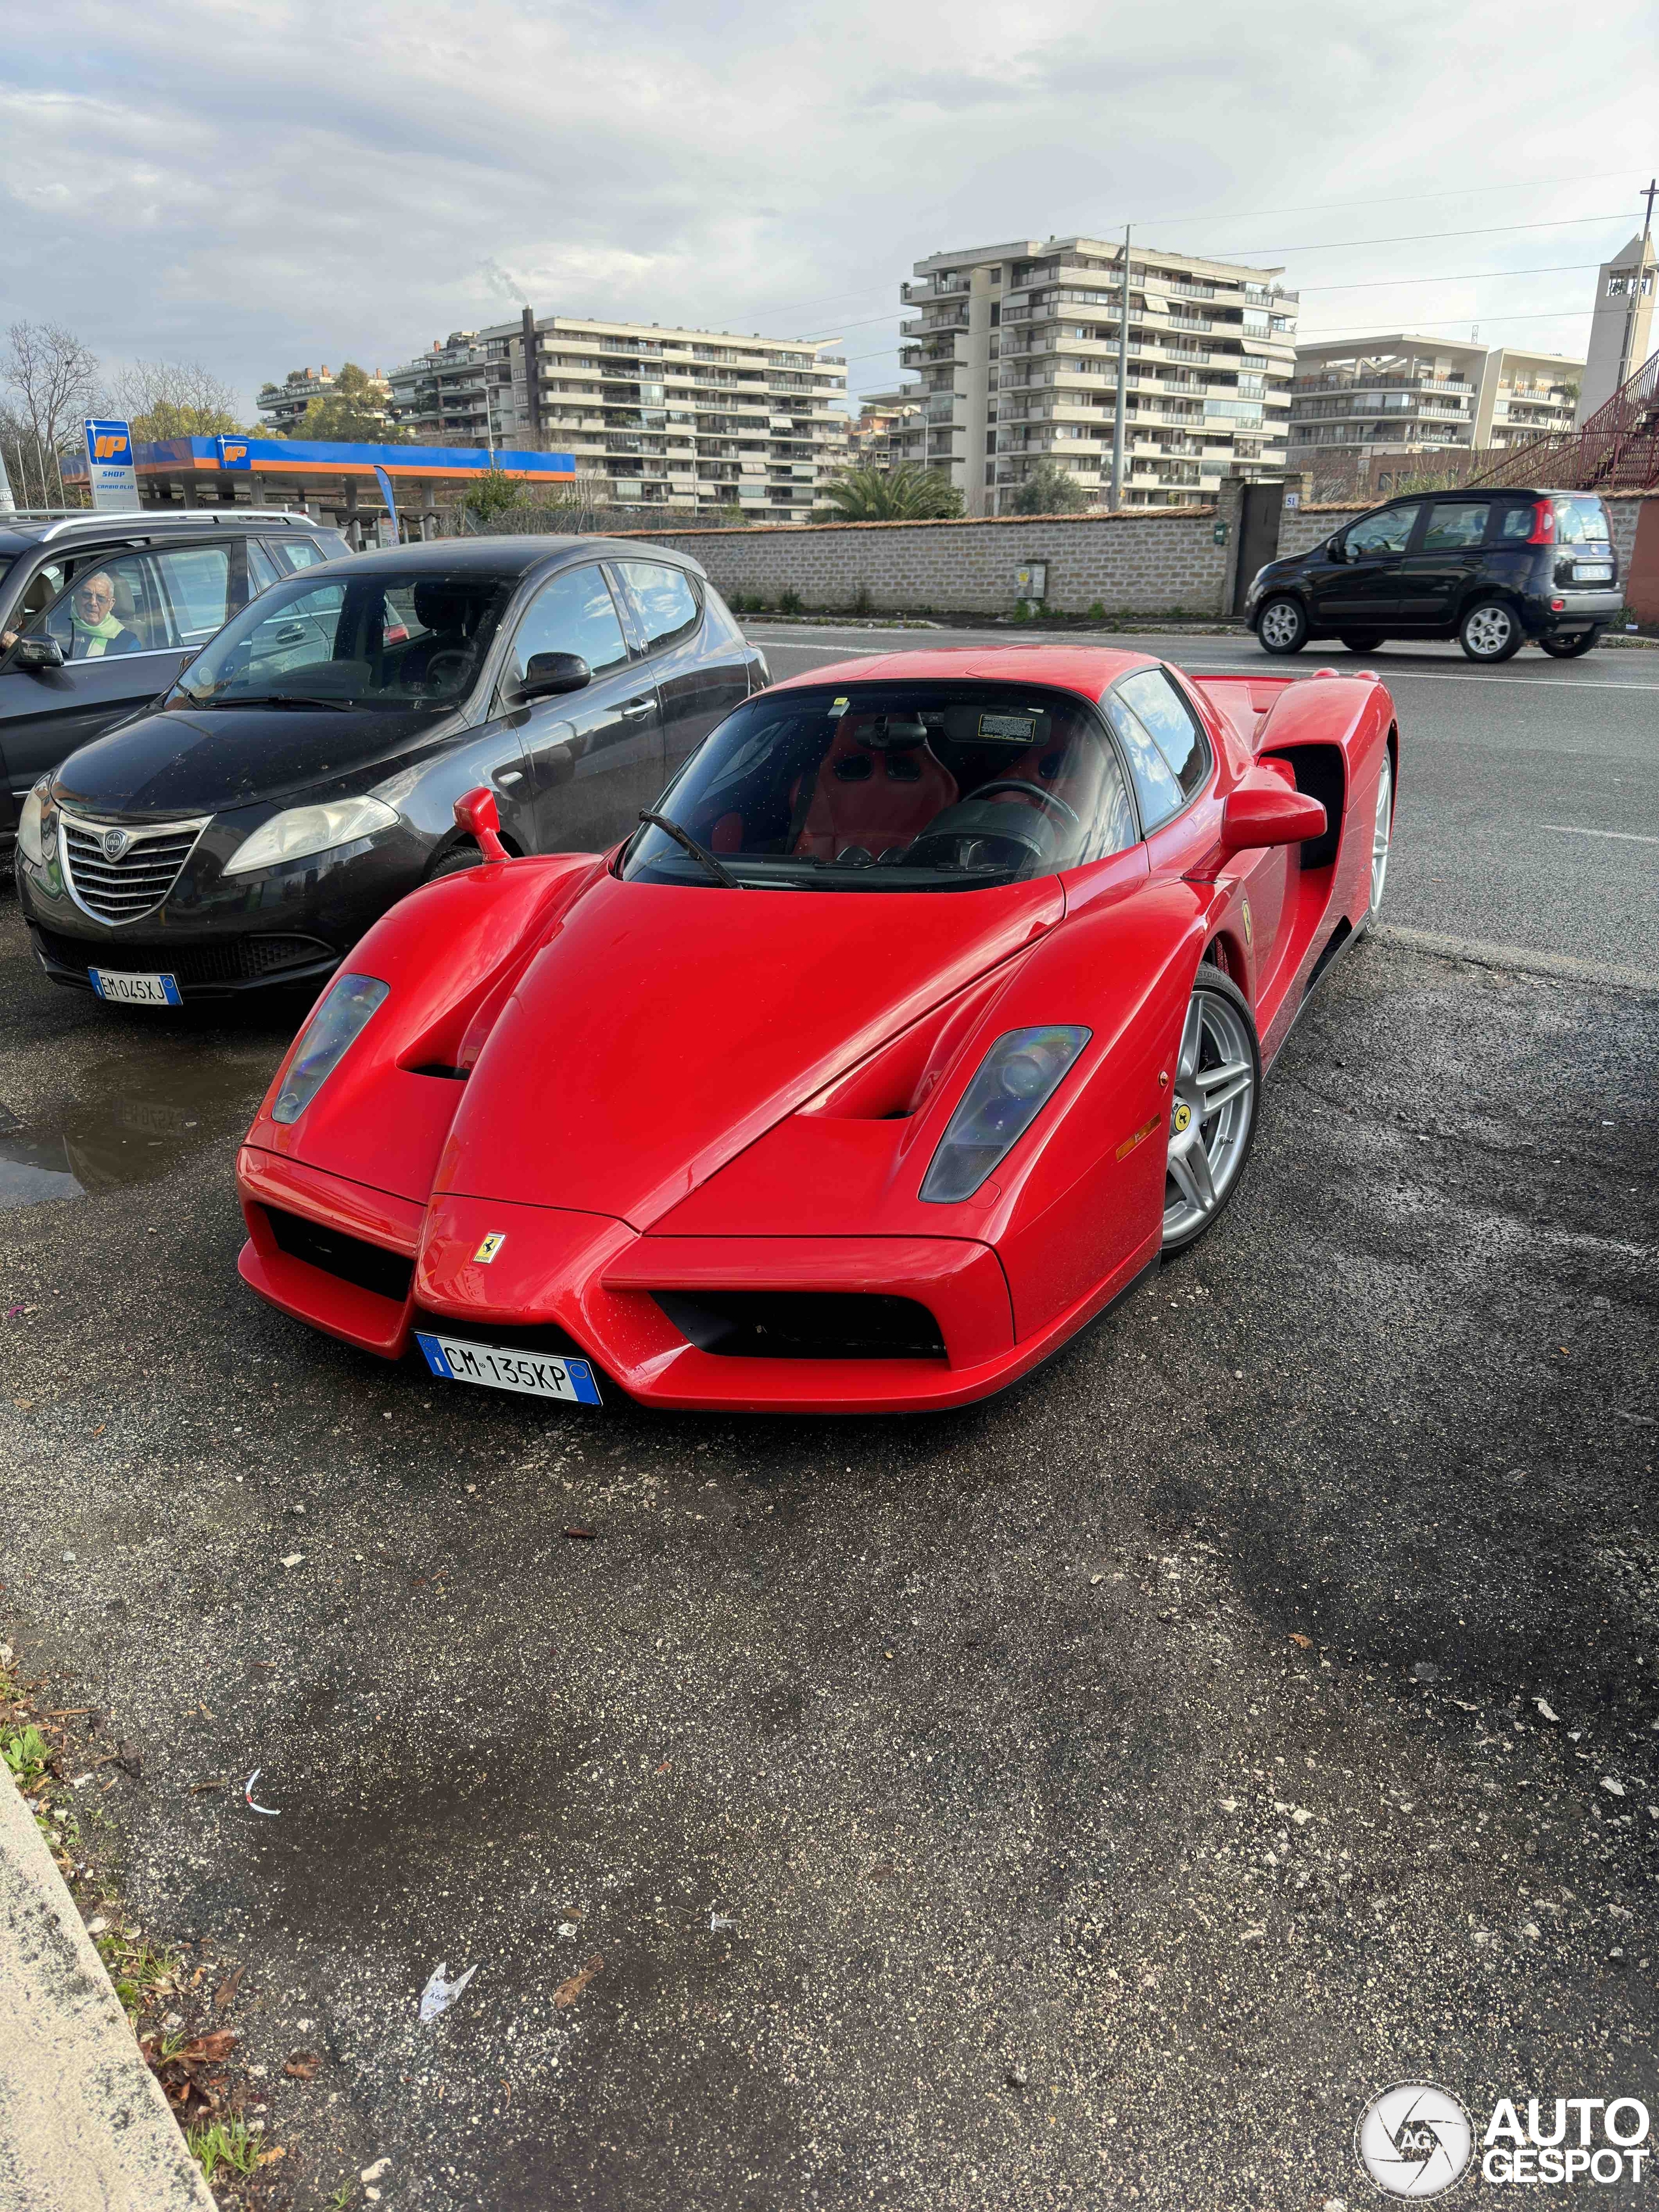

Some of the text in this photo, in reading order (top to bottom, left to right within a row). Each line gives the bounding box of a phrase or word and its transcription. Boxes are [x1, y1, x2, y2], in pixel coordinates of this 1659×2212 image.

[94, 436, 127, 458] IP
[223, 446, 247, 461] IP
[1287, 497, 1295, 506] 51
